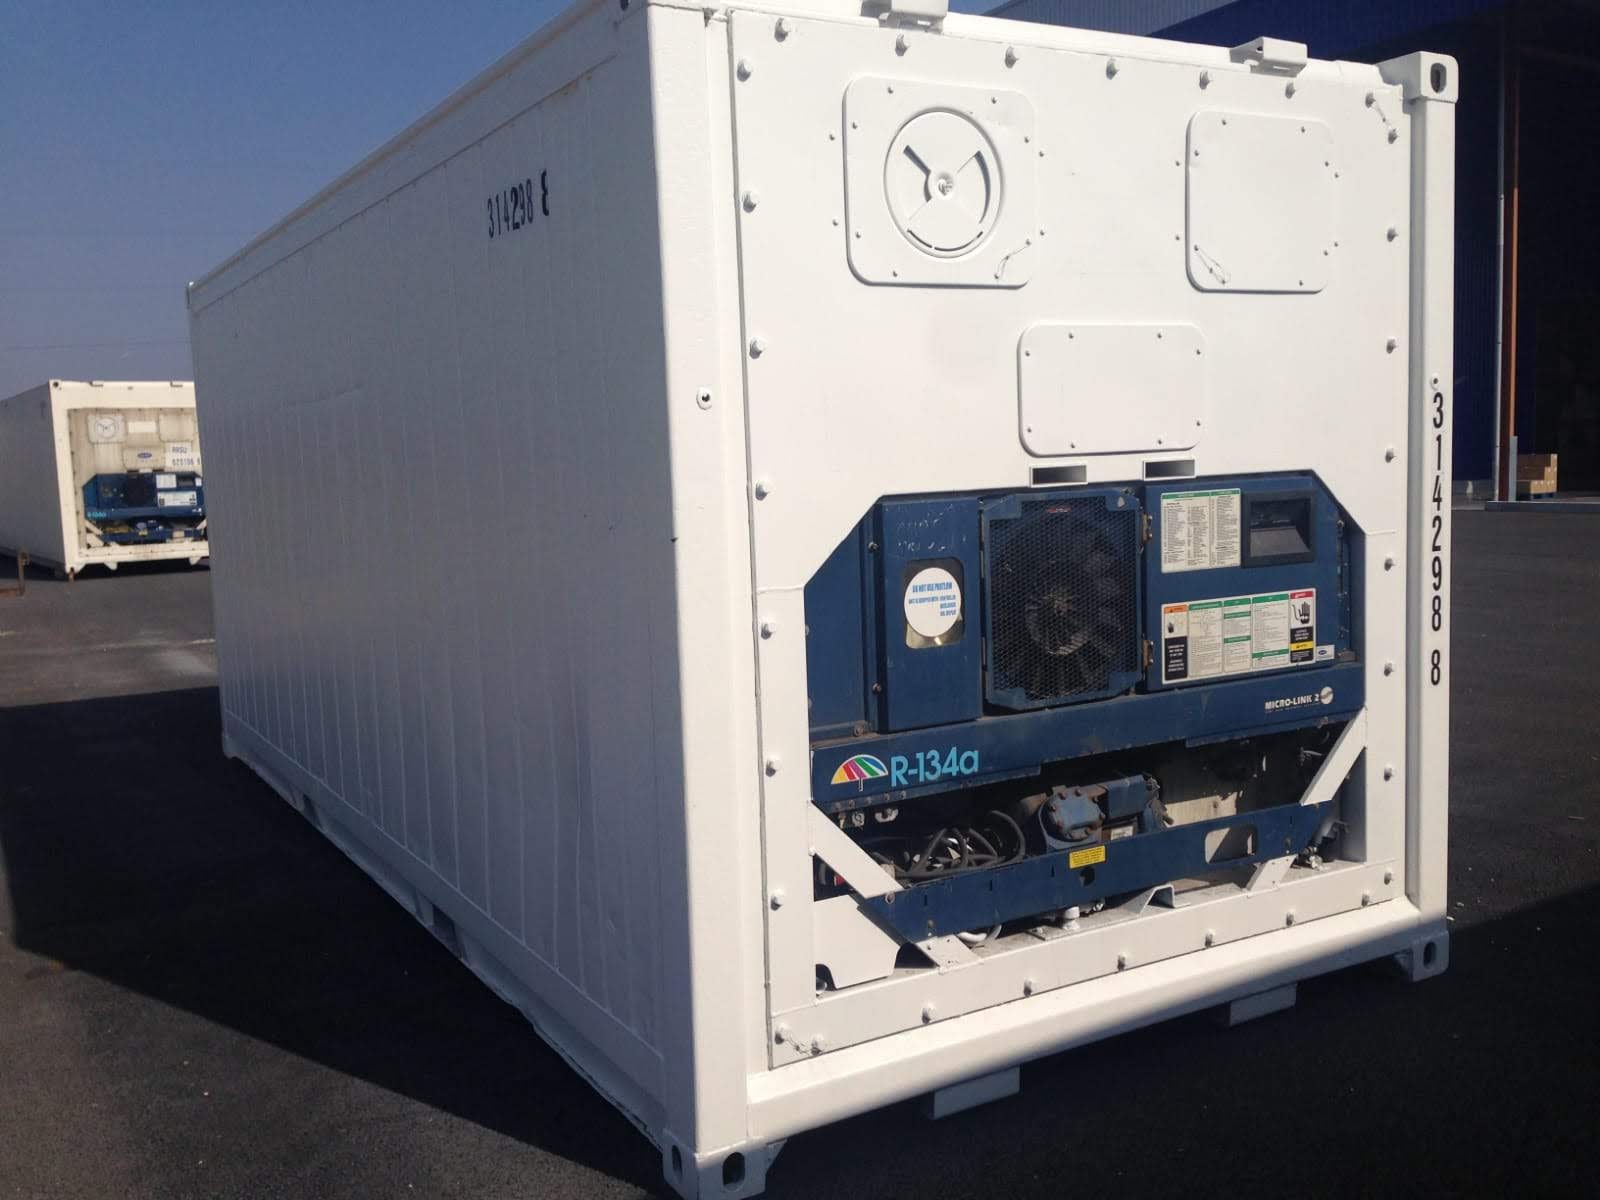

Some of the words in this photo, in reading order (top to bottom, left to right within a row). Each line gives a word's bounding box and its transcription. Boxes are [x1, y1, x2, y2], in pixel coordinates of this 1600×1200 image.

[487, 178, 534, 239] 314298
[1431, 391, 1444, 632] 314298
[1430, 649, 1441, 686] 8
[1265, 694, 1313, 709] MICRO-LINK
[890, 746, 980, 788] R-134a
